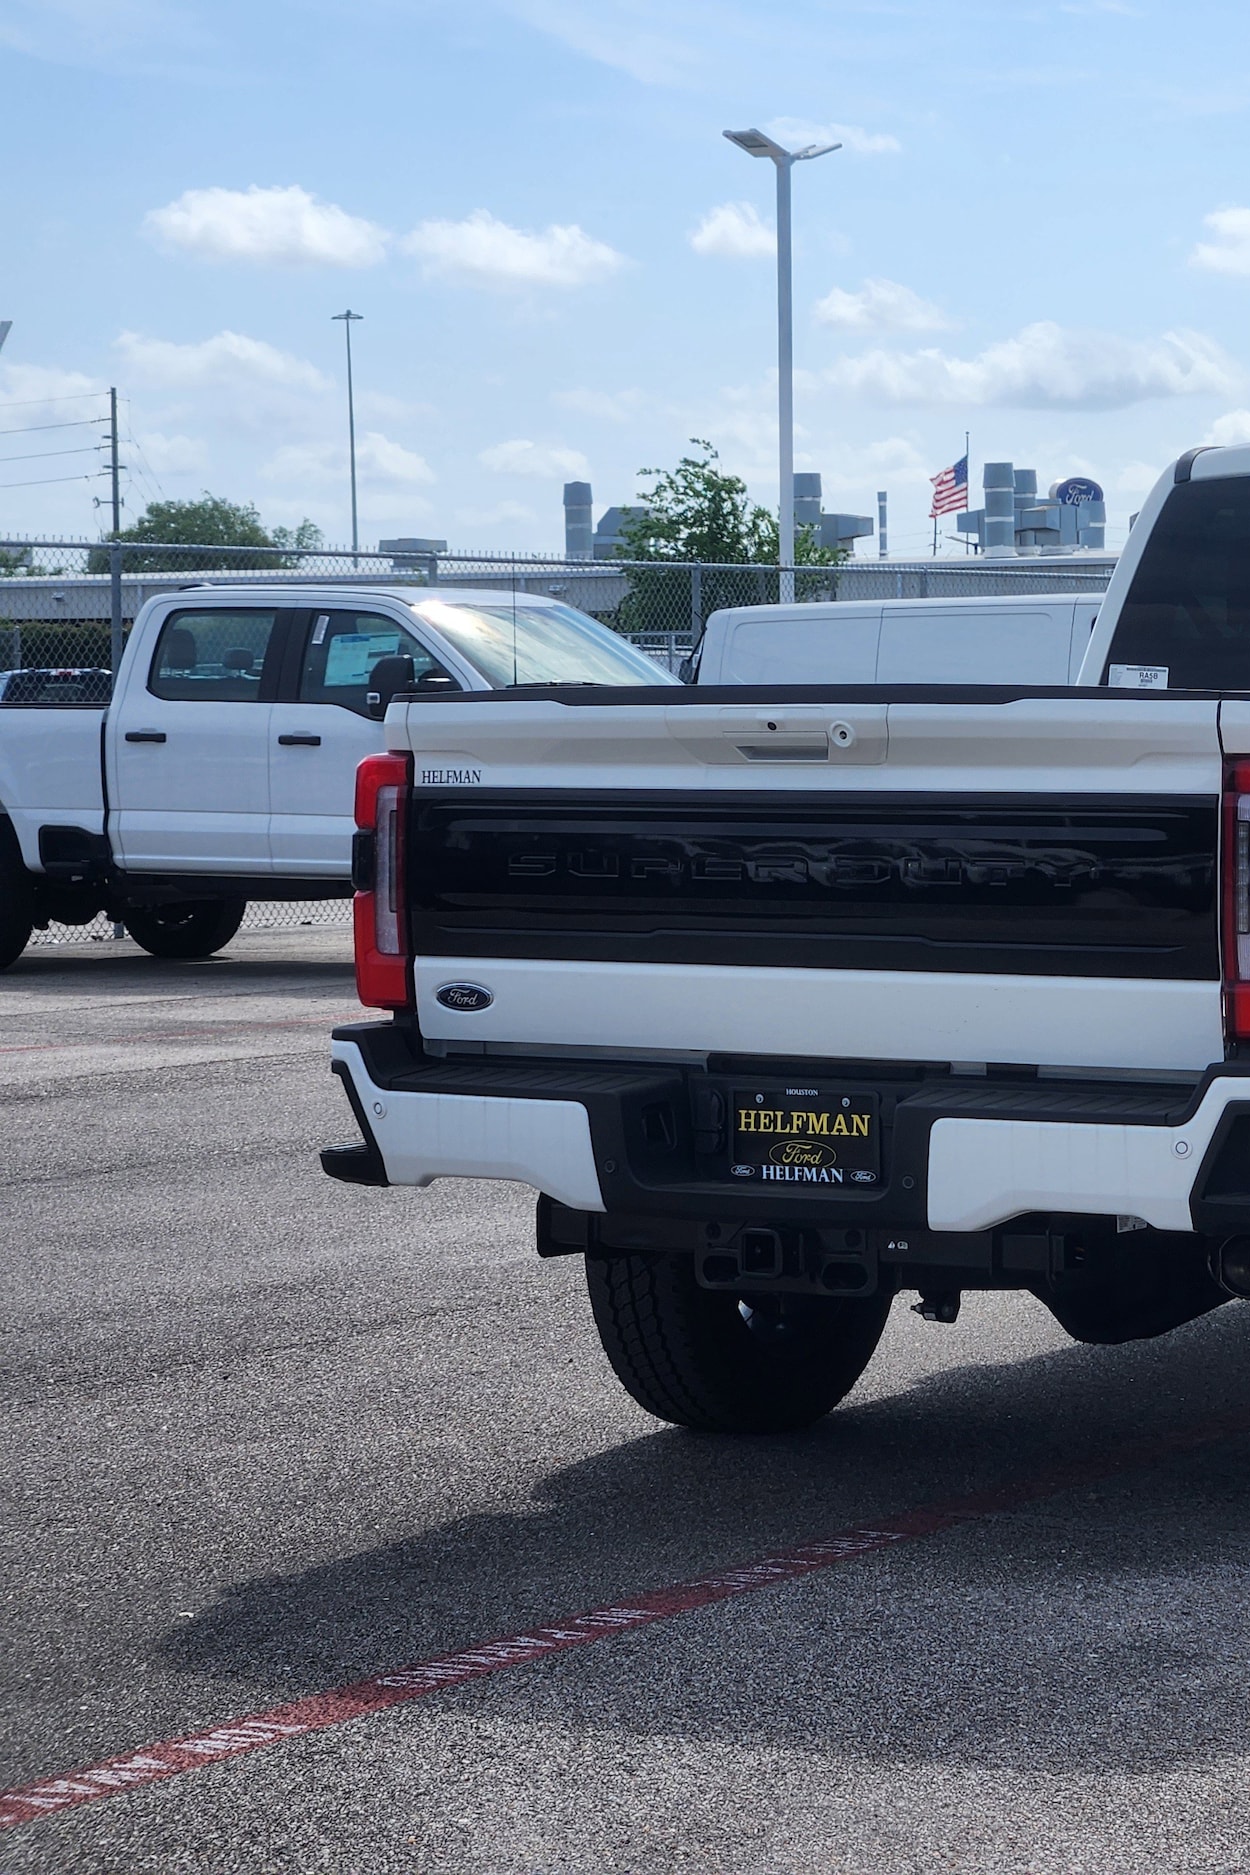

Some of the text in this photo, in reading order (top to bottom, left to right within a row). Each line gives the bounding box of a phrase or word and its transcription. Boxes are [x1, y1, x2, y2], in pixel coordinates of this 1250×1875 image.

[1065, 484, 1095, 505] Ford
[421, 769, 482, 784] HELFMAN
[507, 854, 1100, 888] SUPER DUTY
[447, 988, 478, 1006] Ford
[786, 1088, 819, 1096] HOUSTON
[738, 1109, 871, 1136] HELFMAN
[782, 1143, 823, 1165] Ford
[761, 1165, 843, 1182] HELFMAN
[376, 1607, 663, 1690] NO PARKING
[2, 1721, 308, 1808] TOW AWAY
